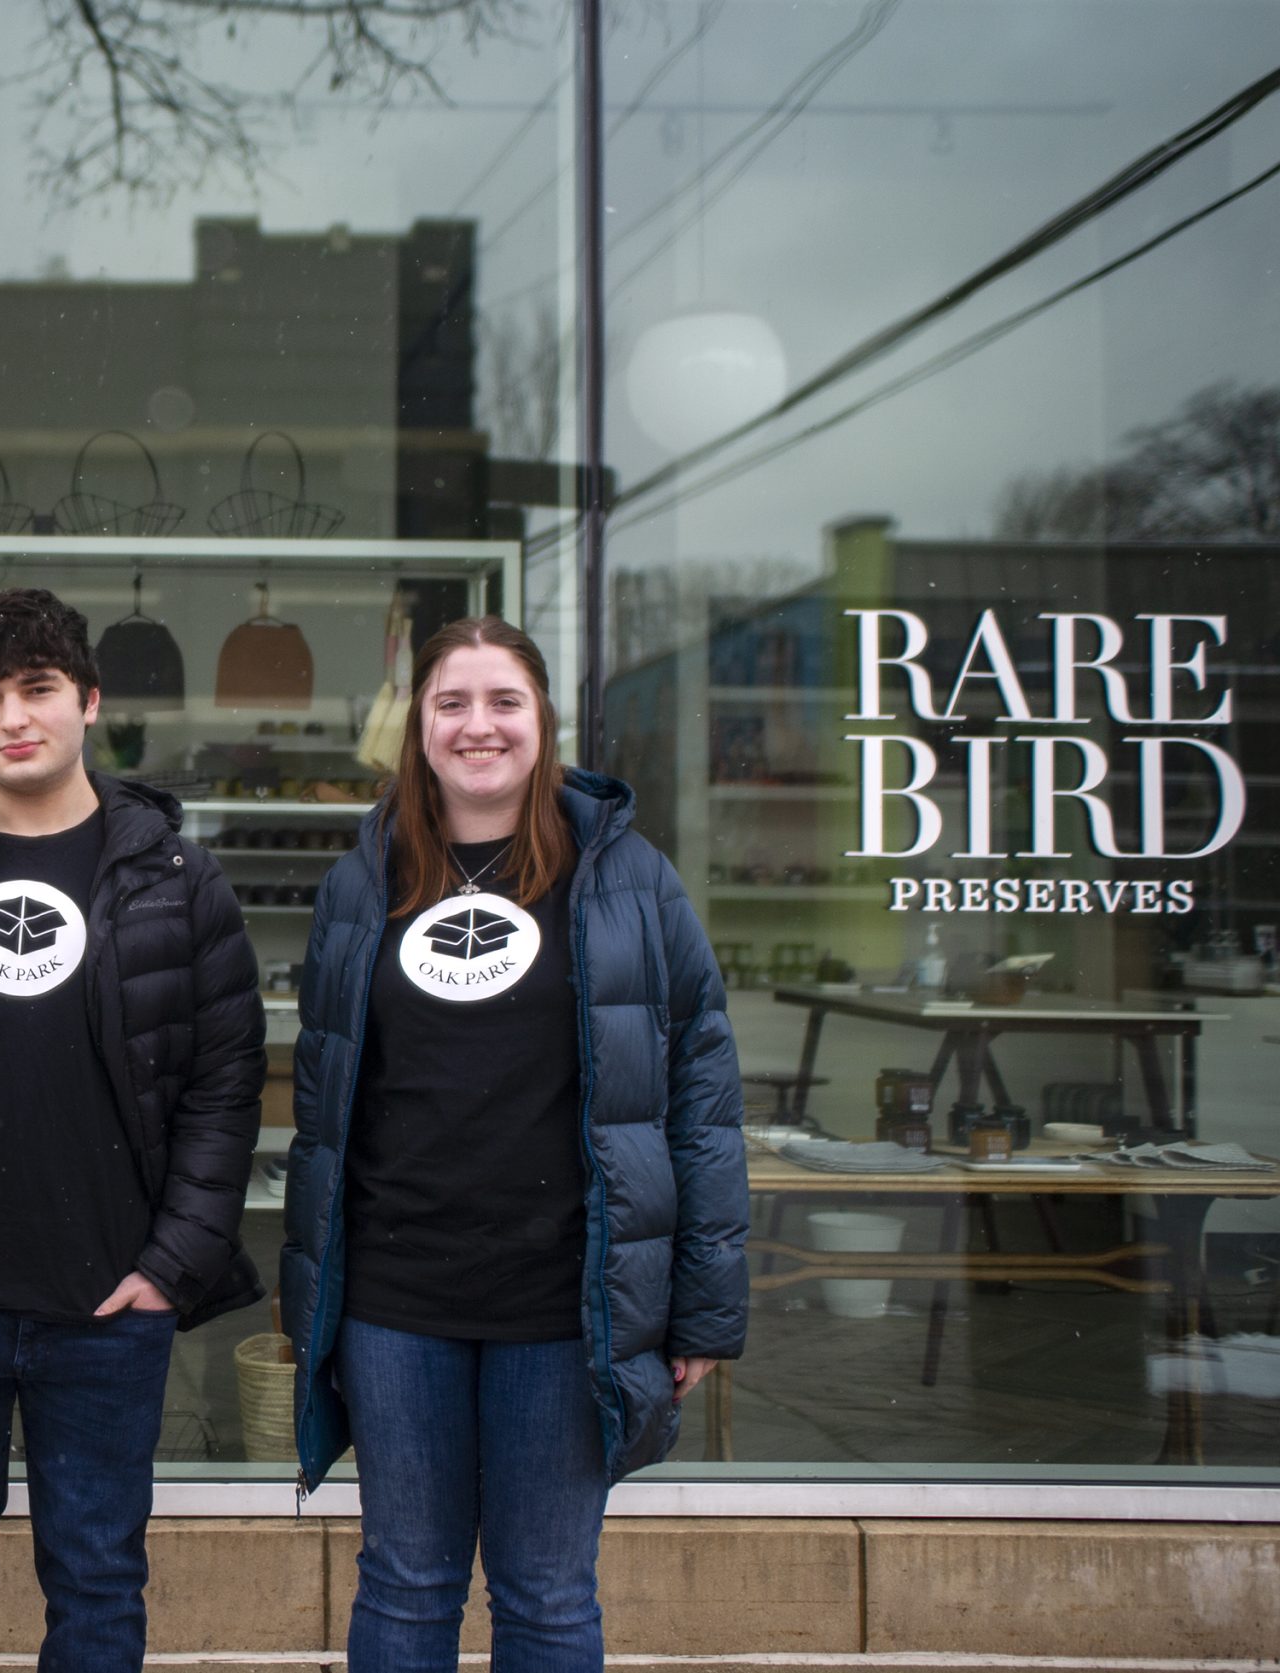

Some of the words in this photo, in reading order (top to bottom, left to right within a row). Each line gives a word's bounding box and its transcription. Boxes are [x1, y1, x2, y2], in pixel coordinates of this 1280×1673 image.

[845, 610, 1230, 723] RARE
[845, 735, 1244, 858] BIRD
[891, 878, 1192, 913] PRESERVES
[15, 955, 64, 981] PARK
[418, 962, 459, 985] OAK
[465, 956, 517, 985] PARK
